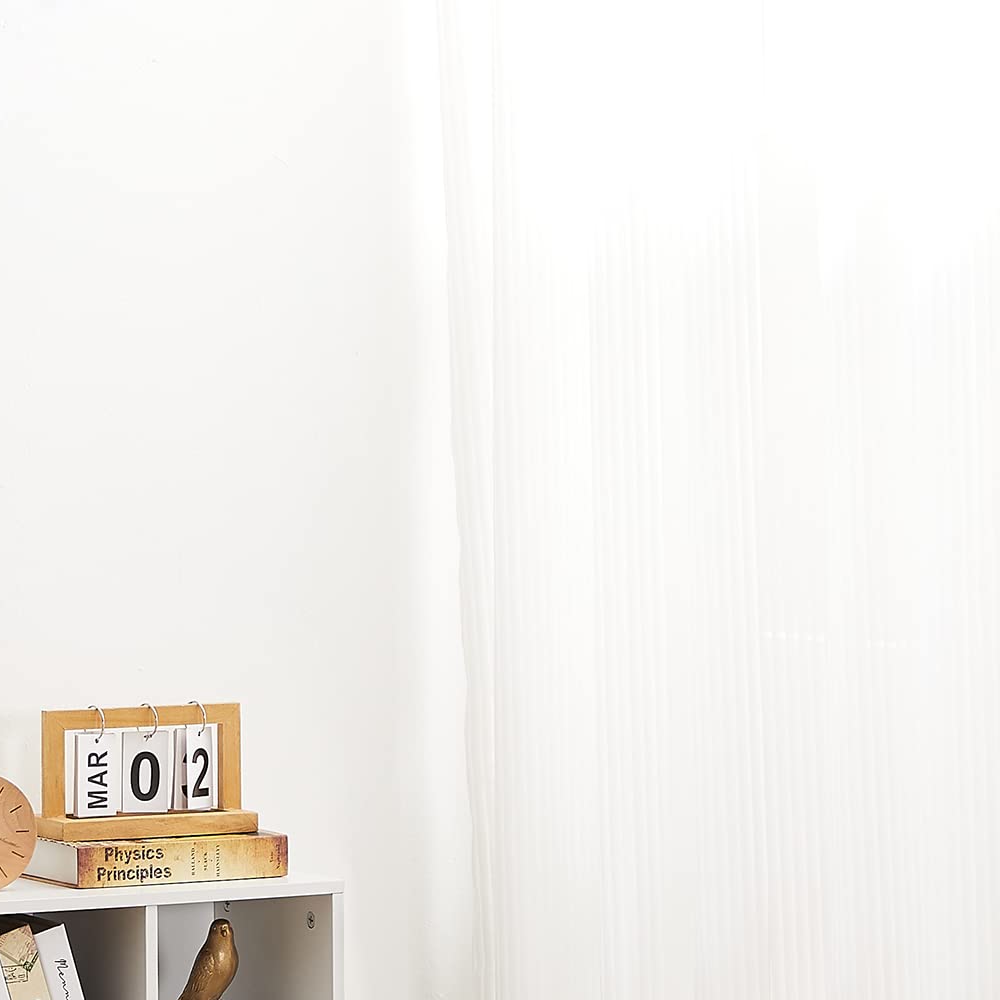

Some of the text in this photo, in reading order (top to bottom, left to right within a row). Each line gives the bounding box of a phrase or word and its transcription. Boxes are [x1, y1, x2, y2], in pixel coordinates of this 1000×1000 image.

[87, 747, 210, 809] MAR 0 2
[104, 845, 165, 865] Physics
[96, 863, 172, 883] Principles
